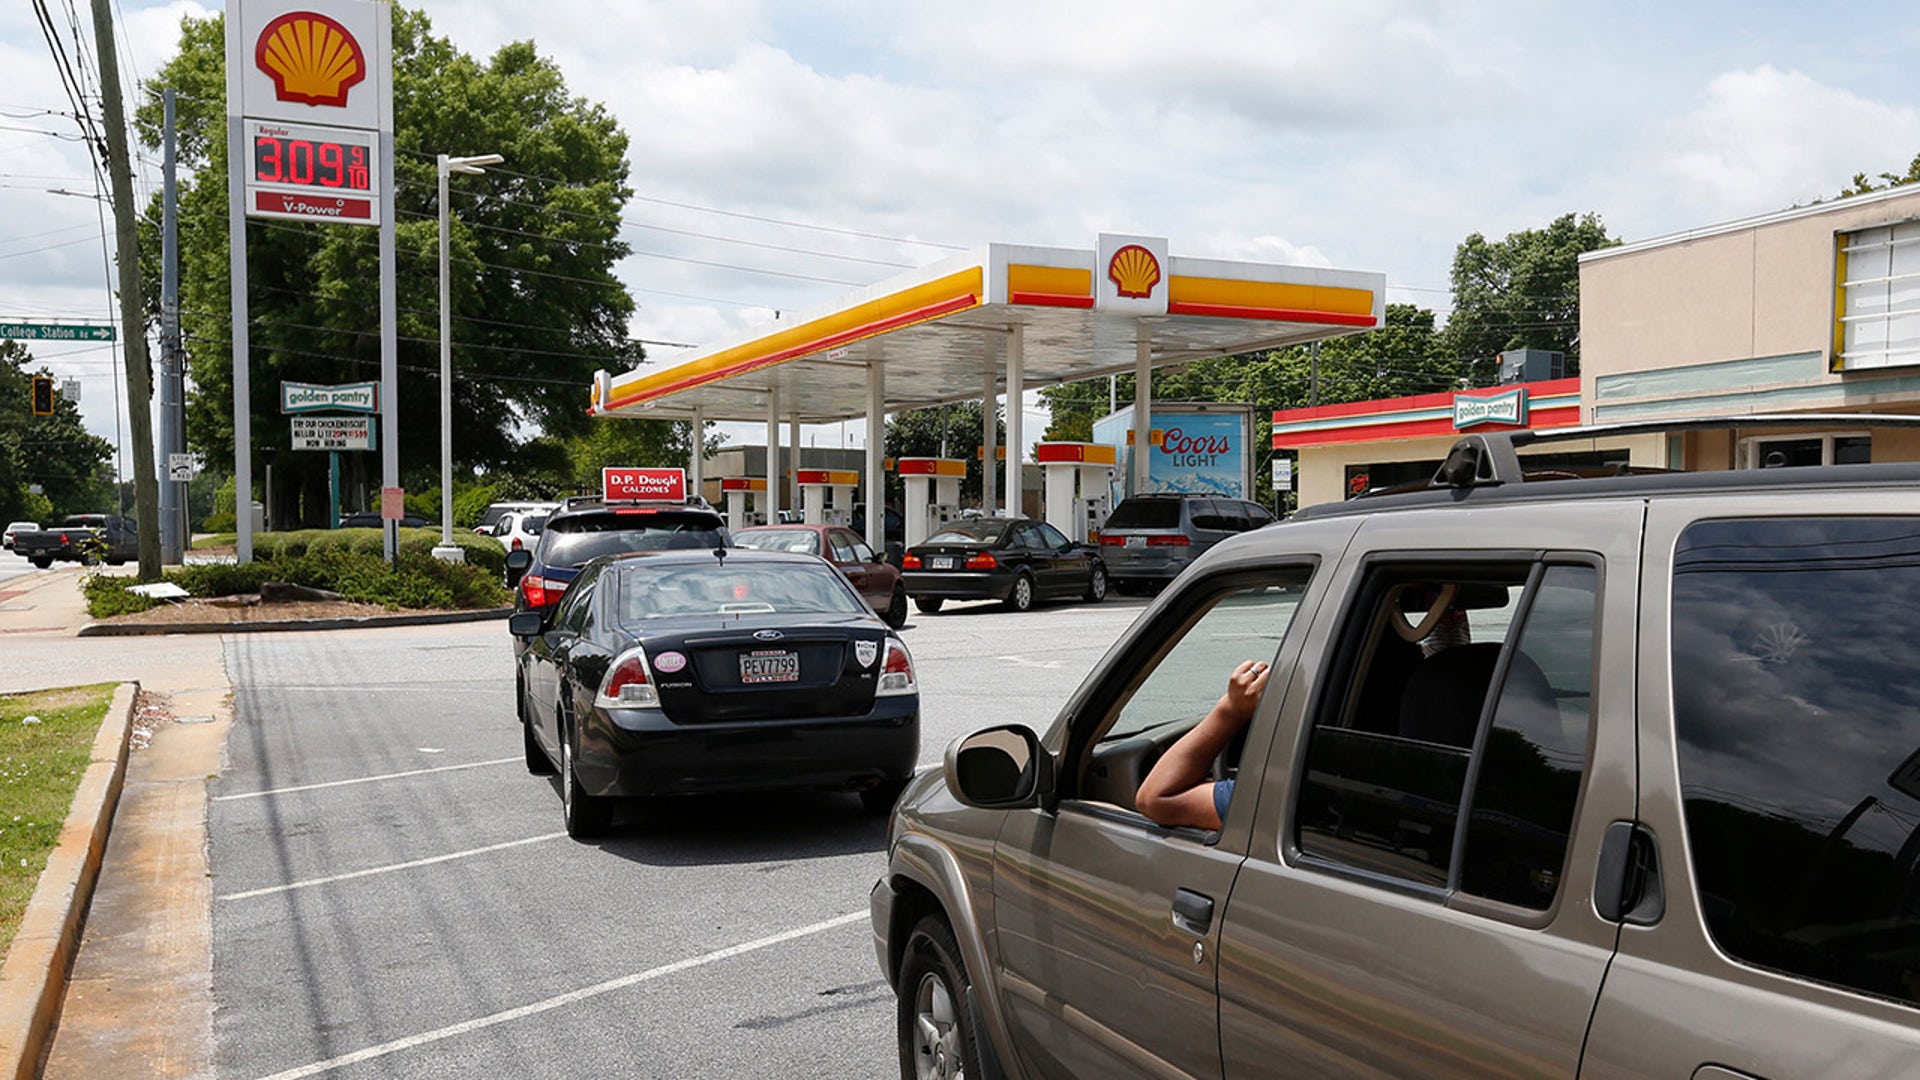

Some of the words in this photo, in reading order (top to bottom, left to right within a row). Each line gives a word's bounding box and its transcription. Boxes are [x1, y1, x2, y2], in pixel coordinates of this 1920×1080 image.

[259, 126, 289, 136] Regular
[257, 137, 345, 188] 3.09
[283, 201, 343, 216] V-Power
[0, 325, 37, 340] College
[41, 326, 75, 339] Station
[289, 388, 328, 405] golden
[332, 391, 370, 405] pantry
[1459, 402, 1486, 419] golden
[1488, 401, 1516, 416] pantry
[1160, 427, 1230, 454] Coors
[927, 461, 936, 473] 3
[1172, 454, 1218, 467] LIGHT
[611, 475, 634, 485] D.P.
[639, 475, 677, 487] Dough
[744, 658, 796, 674] PEV7799
